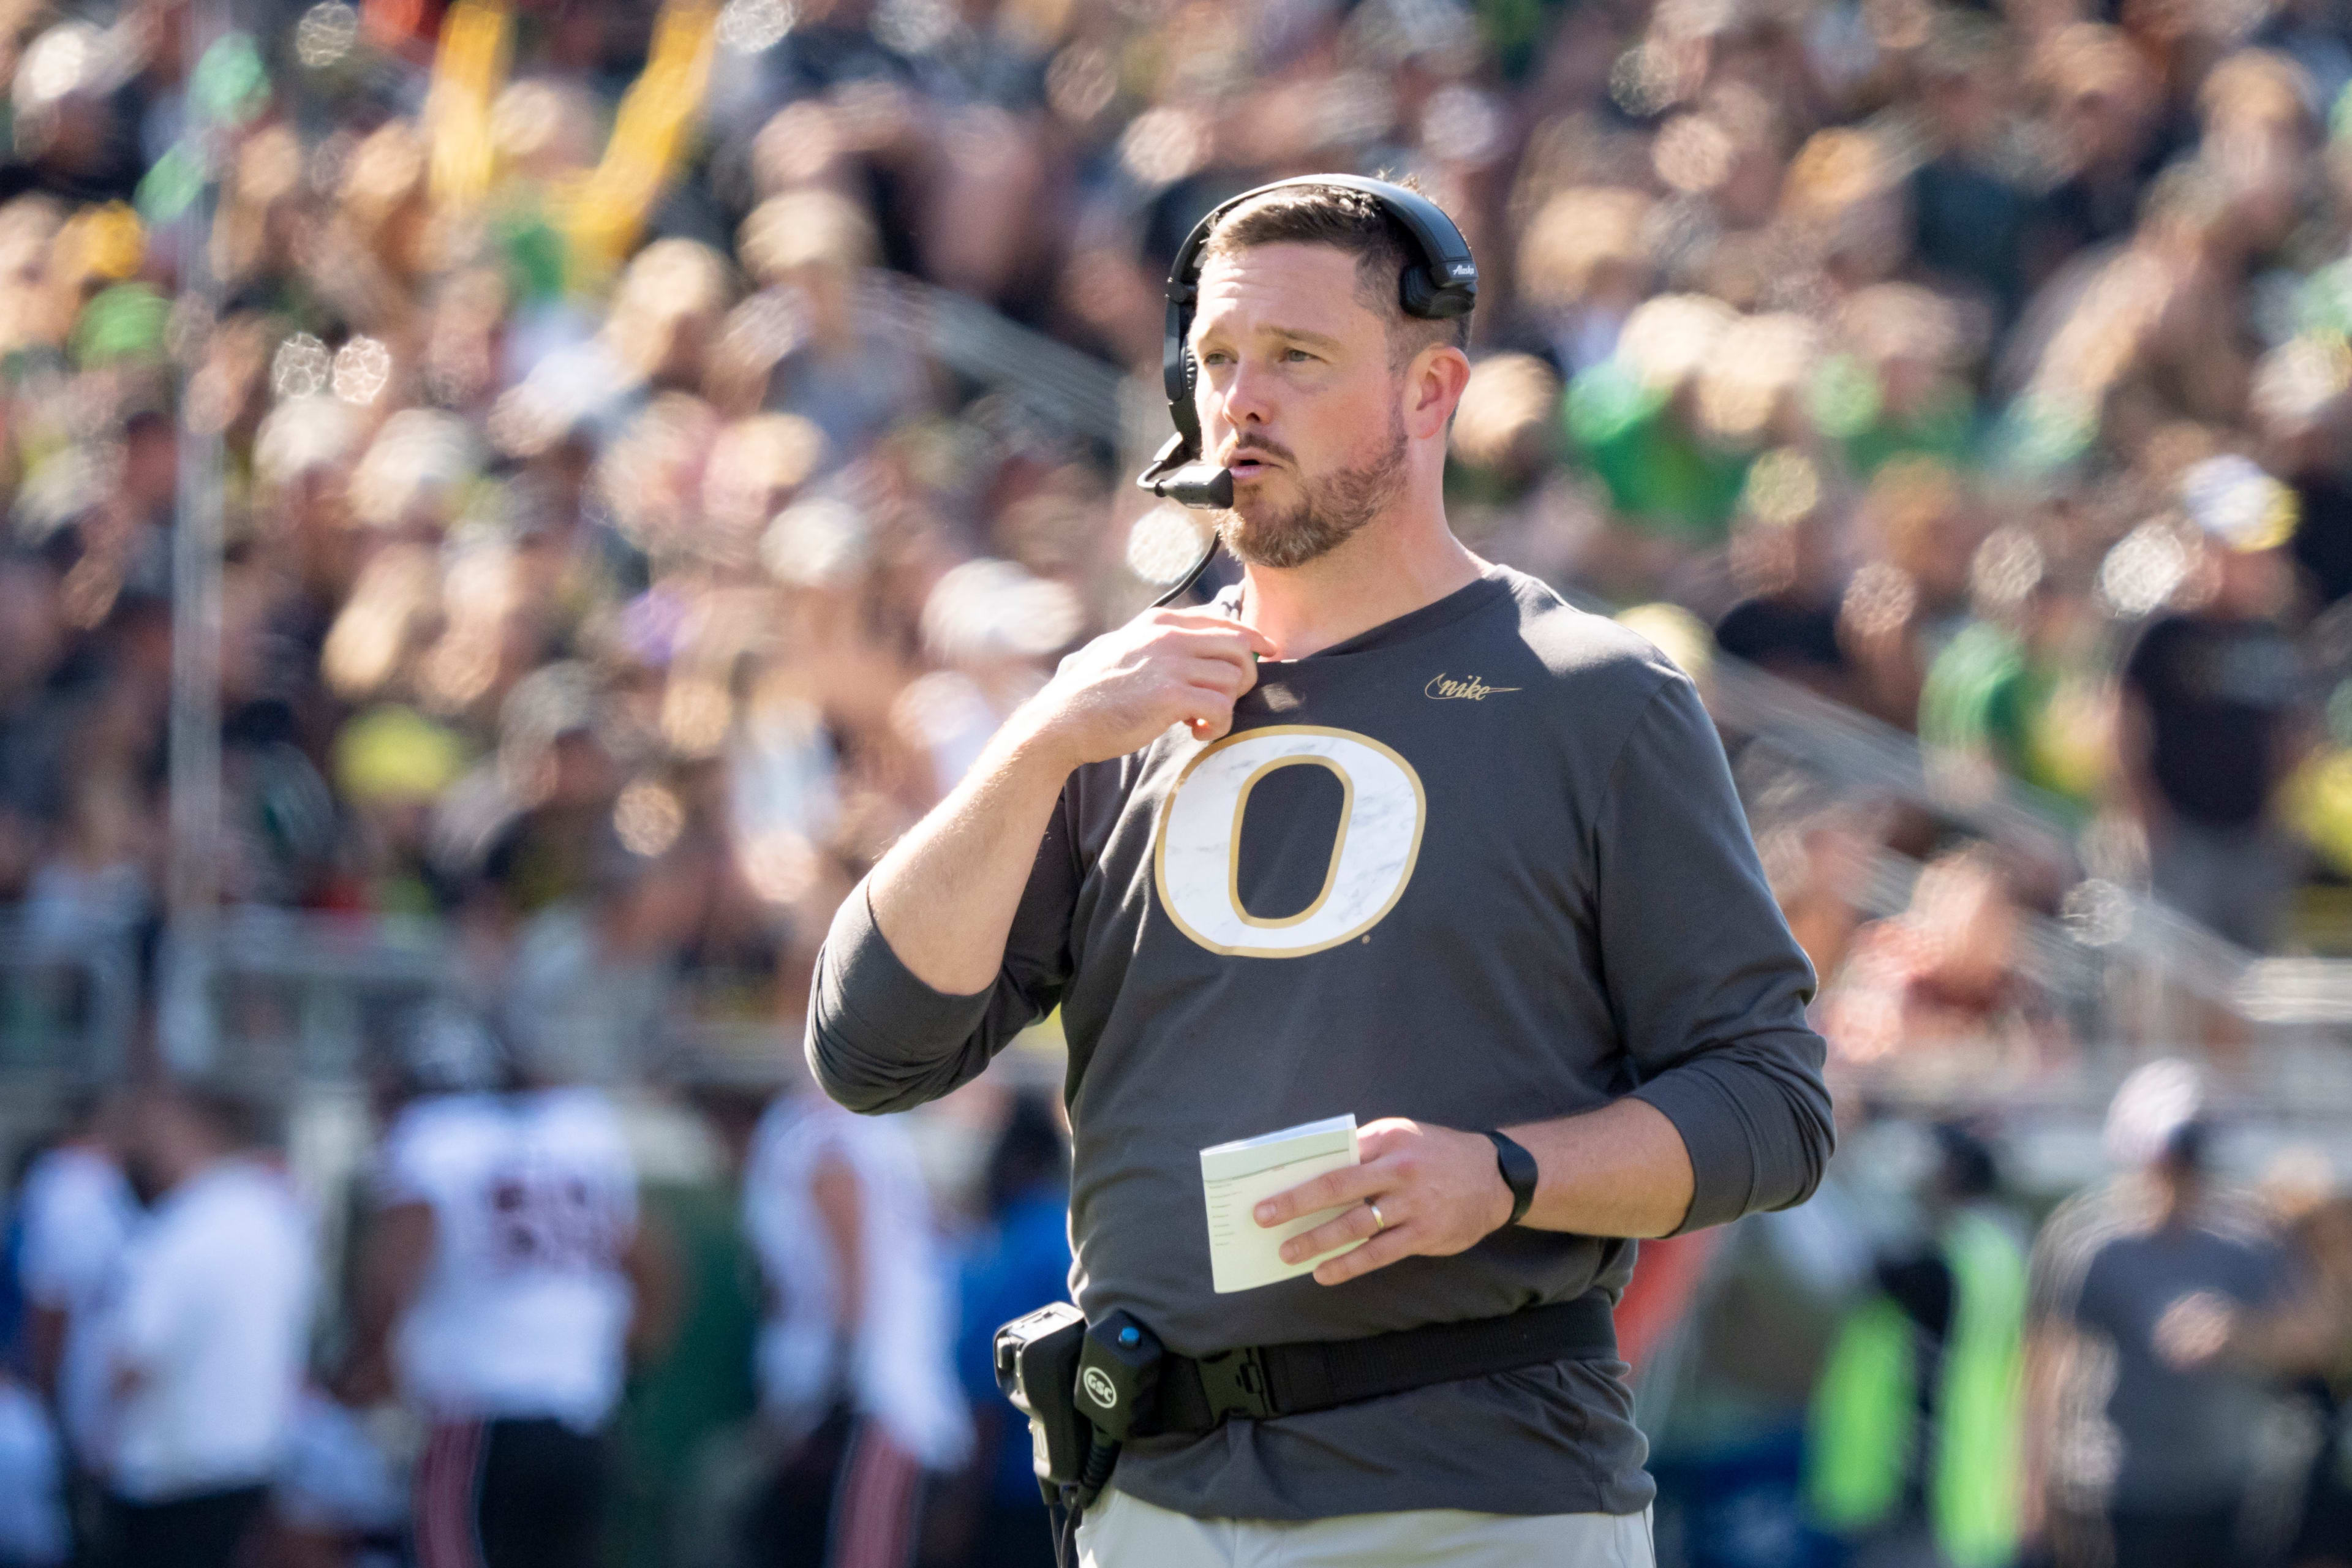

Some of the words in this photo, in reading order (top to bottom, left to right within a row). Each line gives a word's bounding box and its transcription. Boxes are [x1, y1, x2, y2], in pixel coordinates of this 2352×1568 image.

[1452, 264, 1474, 275] Alaska
[1155, 725, 1426, 959] O
[1087, 1374, 1112, 1402] GSC
